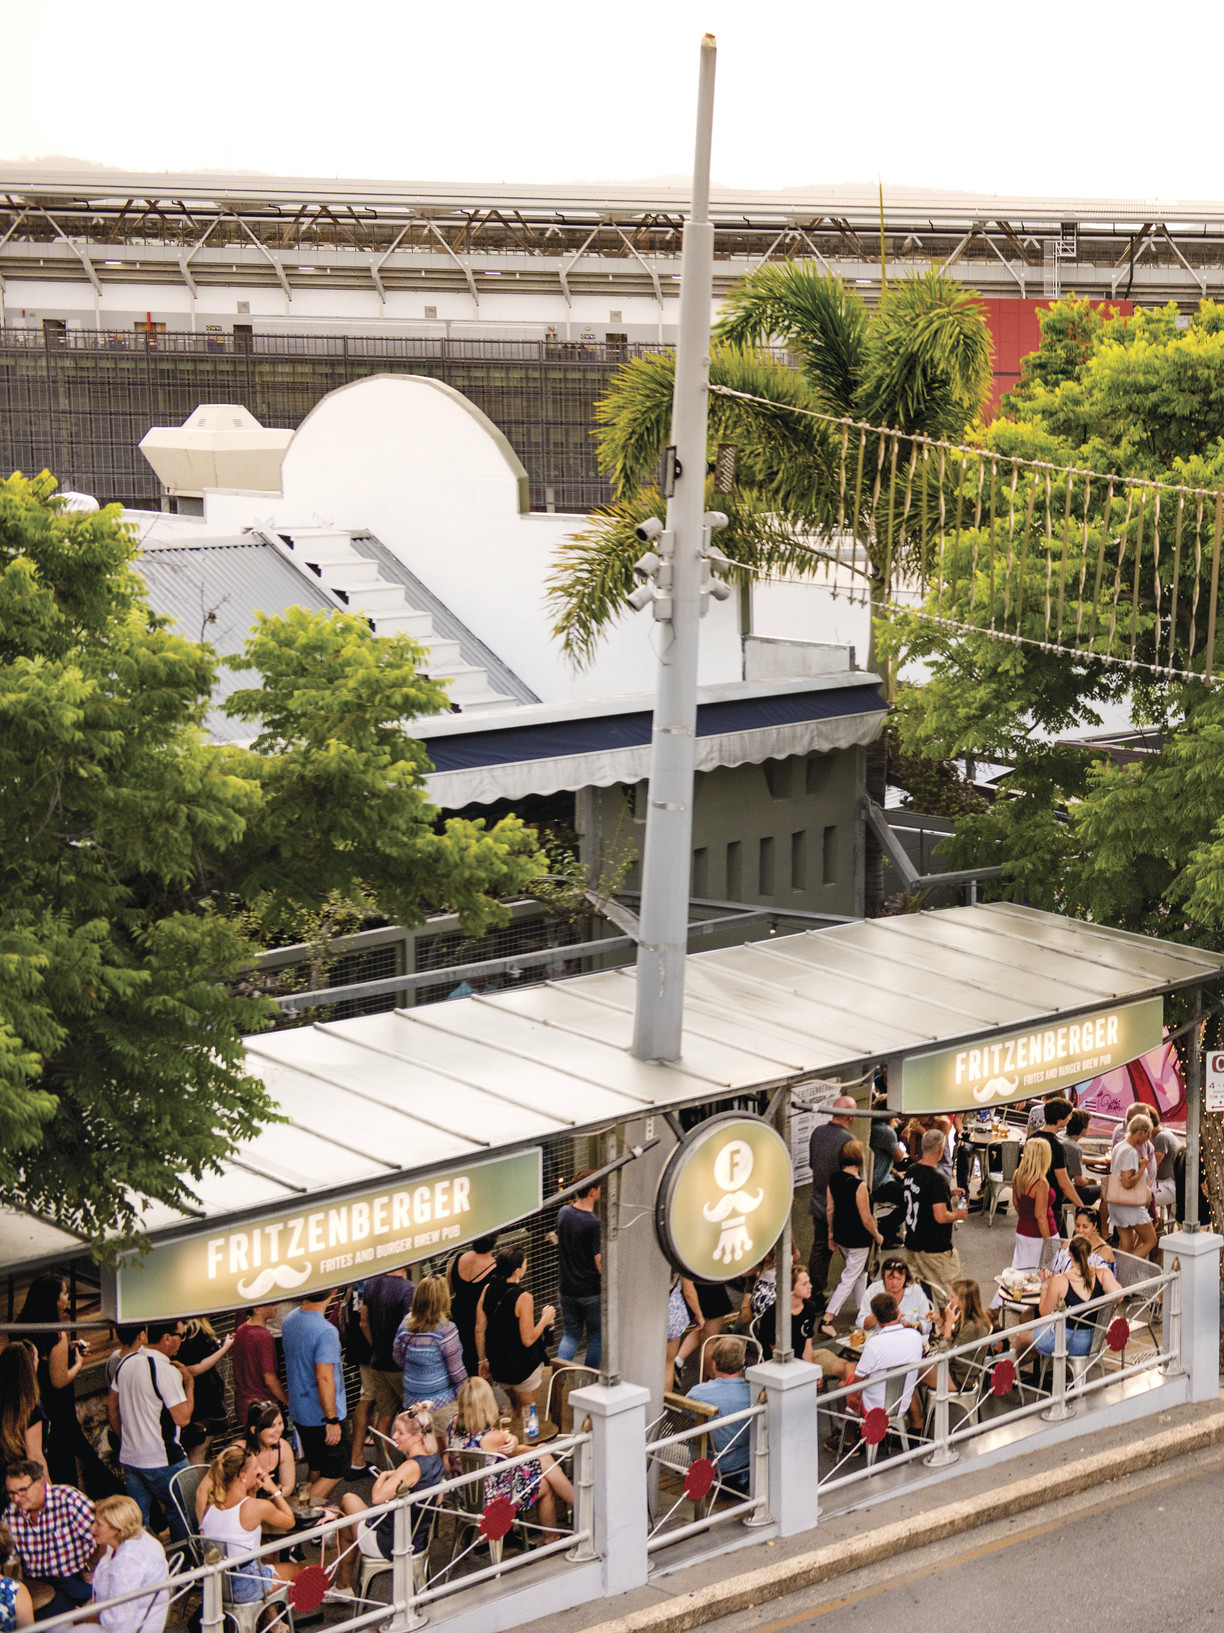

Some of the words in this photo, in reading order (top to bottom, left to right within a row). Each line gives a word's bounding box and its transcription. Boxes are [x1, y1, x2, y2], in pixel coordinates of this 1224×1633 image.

[955, 1015, 1119, 1084] FRITZENBERGER
[1023, 1071, 1045, 1086] FRITES
[1045, 1067, 1057, 1080] AND
[1058, 1061, 1081, 1076] BURGER
[1082, 1057, 1099, 1071] BREW
[1099, 1053, 1112, 1066] PUB
[1209, 1081, 1215, 1089] 4
[729, 1148, 741, 1183] F
[207, 1176, 471, 1280] FRITZENBERGER
[319, 1254, 354, 1274] FRITES
[354, 1248, 375, 1266] AND
[376, 1237, 413, 1257] BURGER
[414, 1230, 441, 1248] BREW
[441, 1223, 461, 1241] PUB
